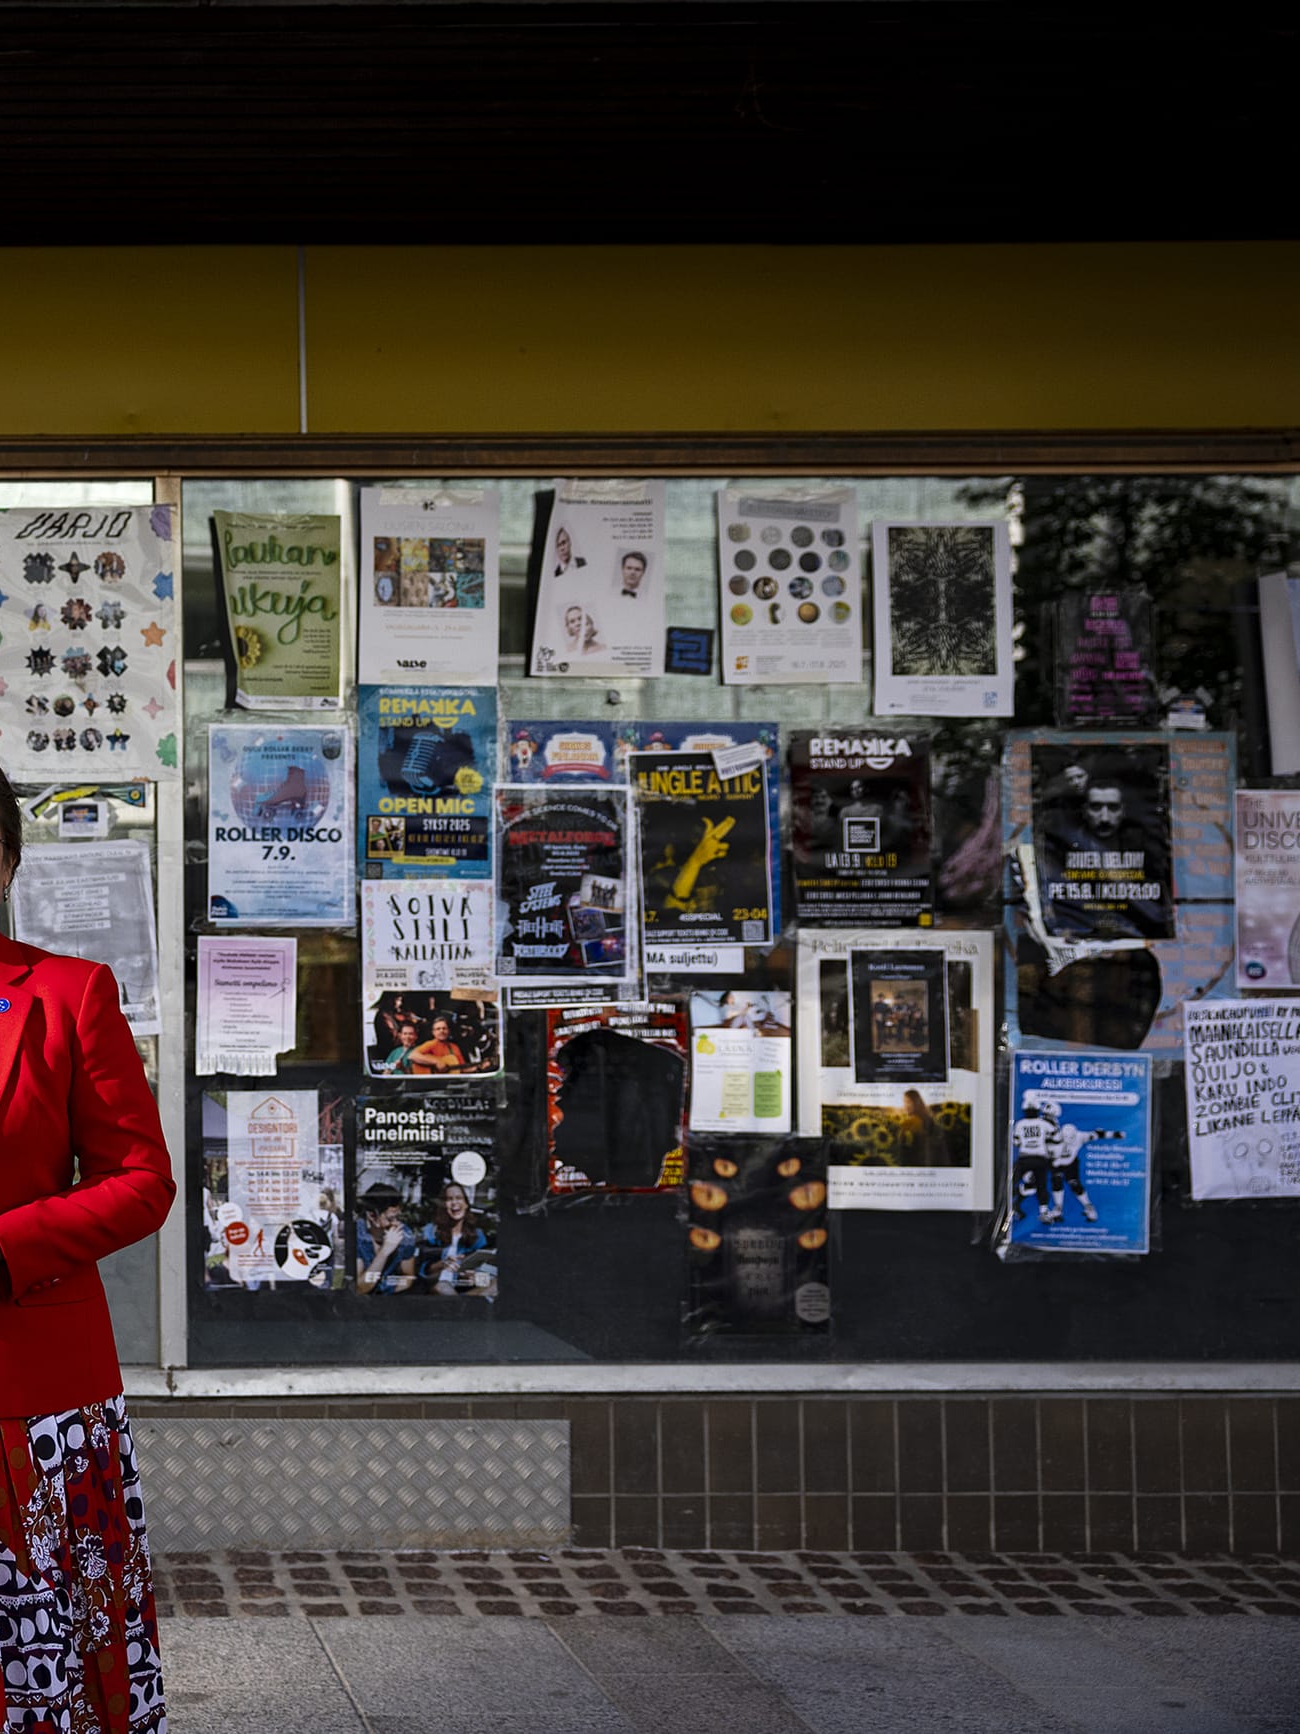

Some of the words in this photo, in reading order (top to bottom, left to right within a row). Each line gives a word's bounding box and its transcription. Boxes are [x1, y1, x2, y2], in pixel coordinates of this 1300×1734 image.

[379, 698, 476, 716] REMAKKA
[379, 717, 414, 728] STAND
[416, 717, 432, 727] UP
[810, 738, 913, 758] REMAKKA
[810, 758, 846, 770] STAND
[378, 797, 433, 814] OPEN
[436, 798, 475, 814] MIC
[215, 827, 284, 842] ROLLER
[288, 828, 342, 843] DISCO
[262, 846, 296, 861] 7.9.
[387, 894, 473, 918] SOIVA
[1020, 1060, 1080, 1078] ROLLER
[364, 1108, 435, 1125] Panosta
[364, 1124, 445, 1142] unelmiisi
